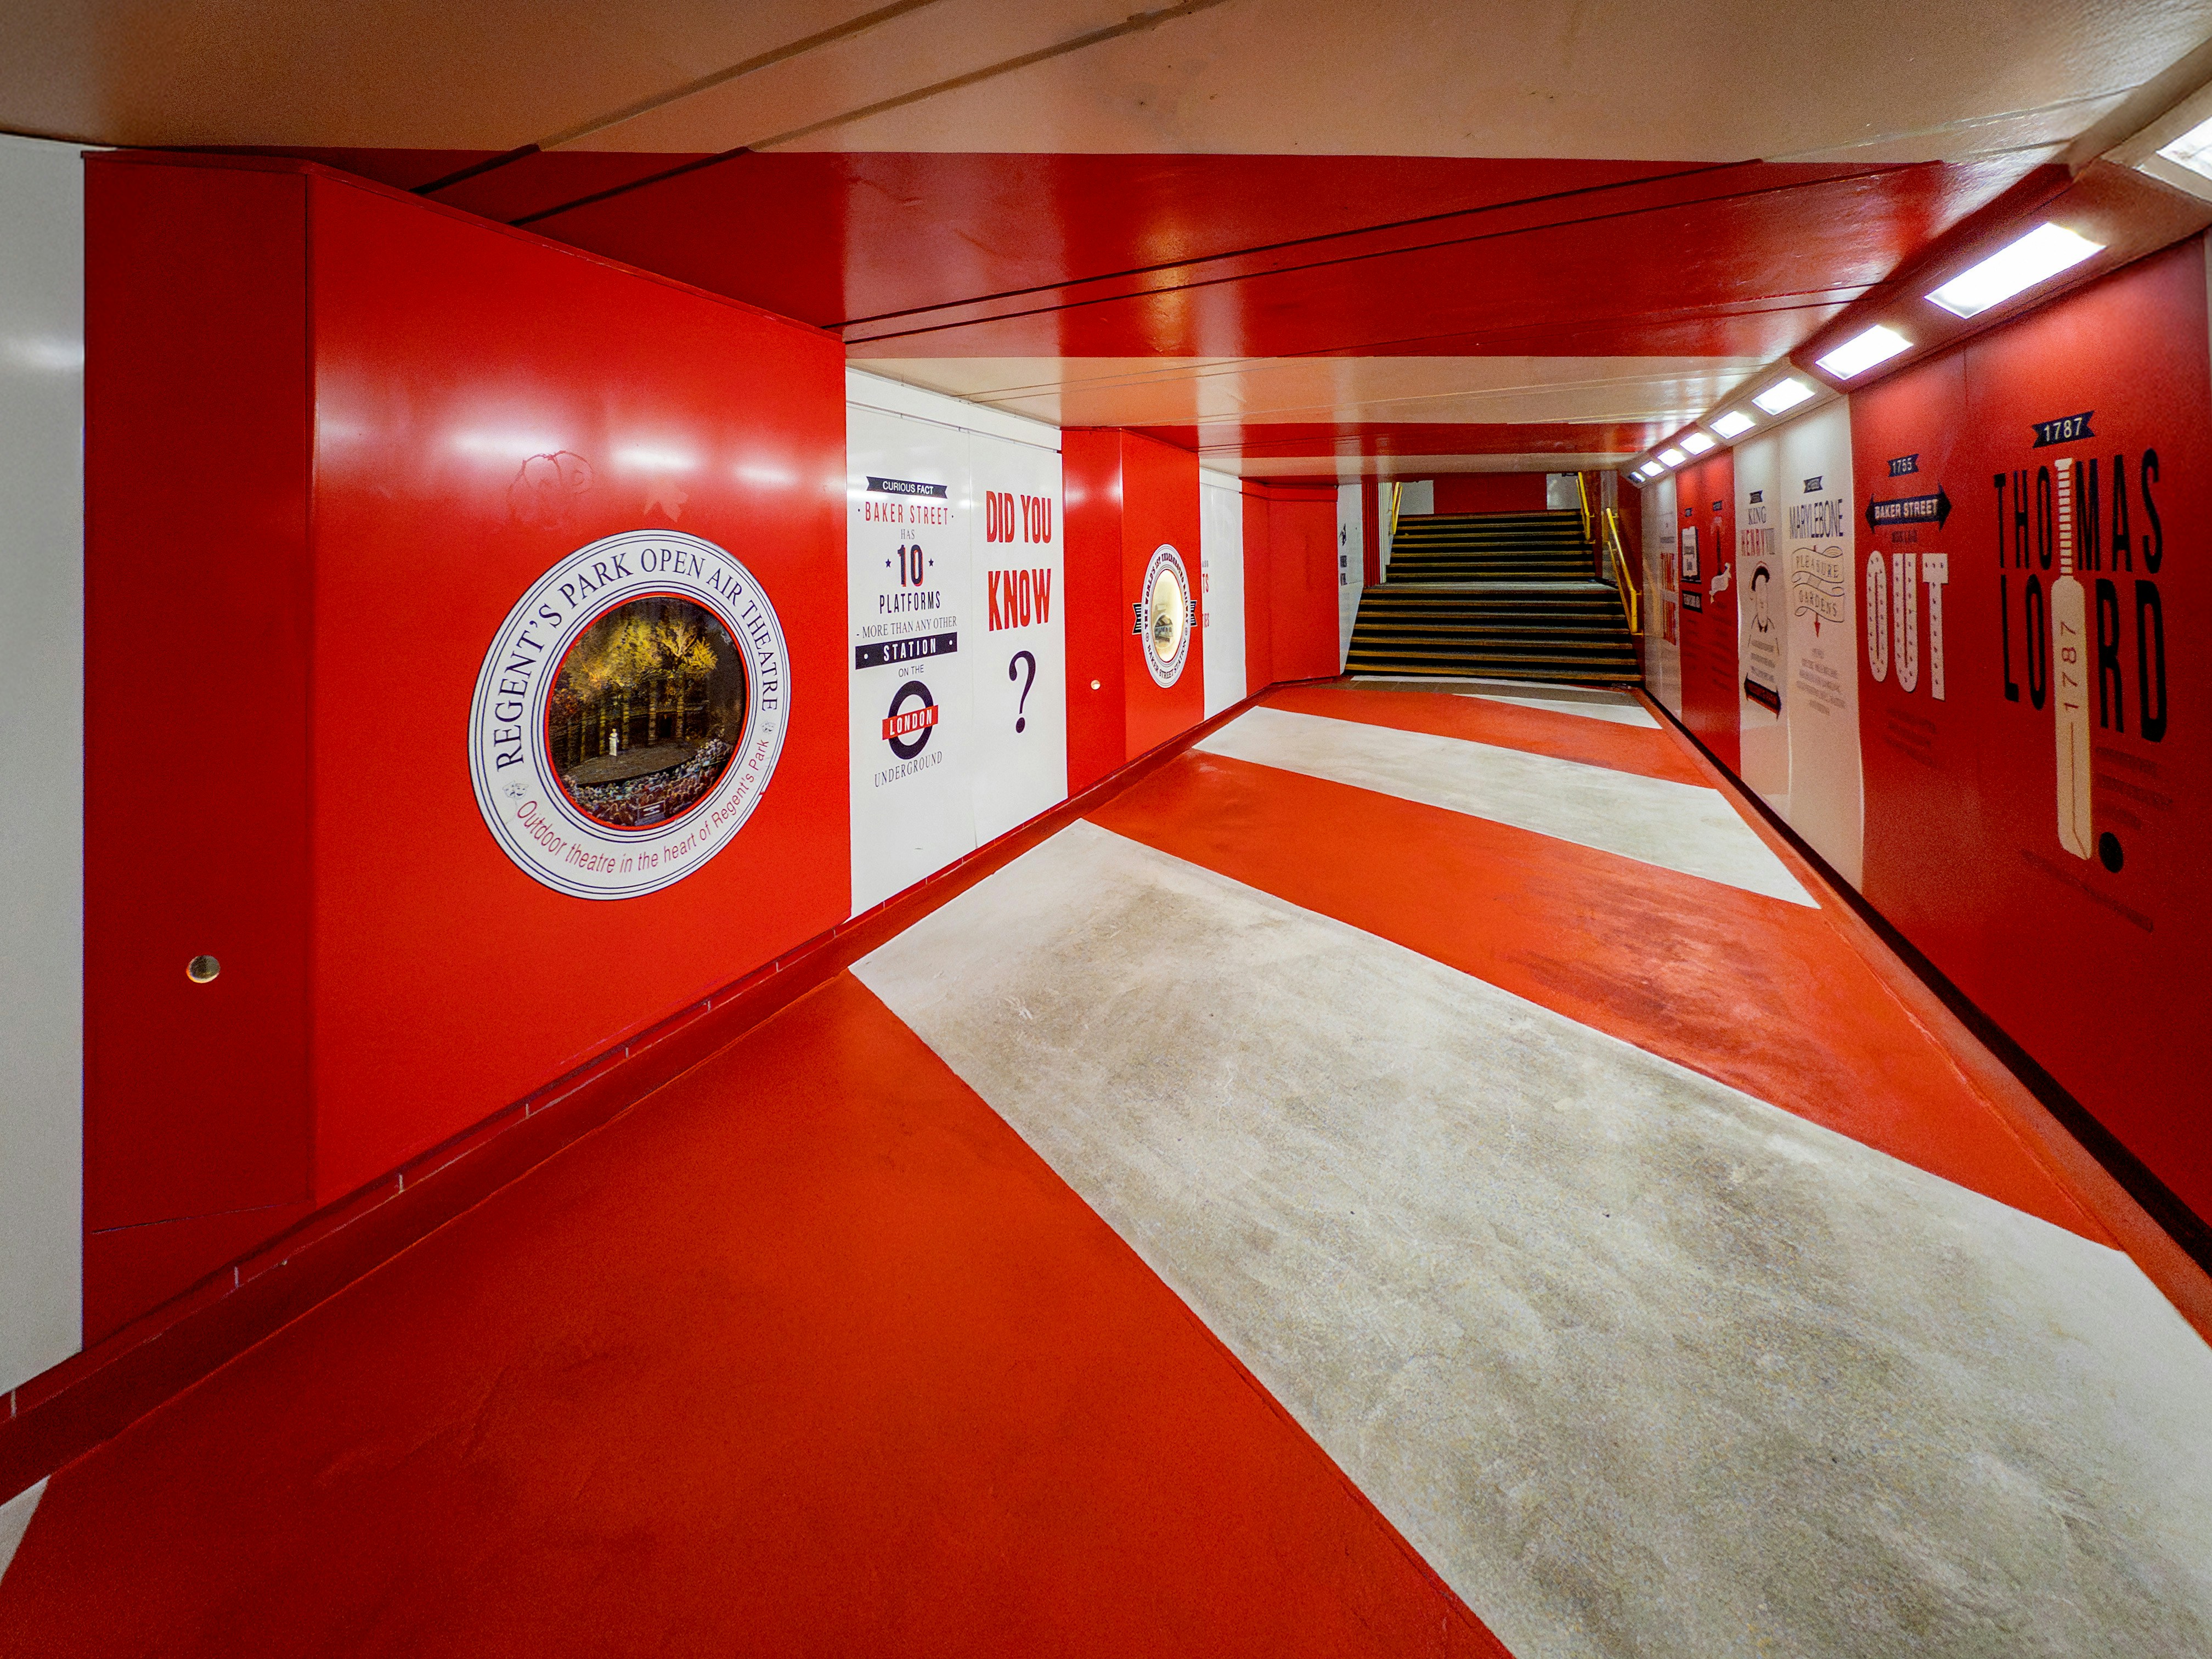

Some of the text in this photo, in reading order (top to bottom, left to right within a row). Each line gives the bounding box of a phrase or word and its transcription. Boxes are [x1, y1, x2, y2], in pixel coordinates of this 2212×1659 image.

[2044, 417, 2083, 442] 1787
[882, 481, 934, 494] CURIOUS FACT
[865, 501, 948, 525] BAKER STREET
[986, 490, 1051, 544] DID YOU
[1748, 506, 1767, 526] KING
[1789, 498, 1844, 539] MARYLEBONE
[1874, 499, 1939, 519] BAKER STREET
[1994, 448, 2163, 574] THOMAS
[900, 529, 915, 540] HAS
[897, 544, 923, 587] 10
[1796, 555, 1838, 578] PLEASURE
[879, 591, 940, 614] PLATFORMS
[988, 568, 1051, 631] KNOW
[1799, 590, 1837, 617] GARDENS
[557, 552, 634, 609] PARK
[641, 549, 706, 579] OPEN
[706, 567, 743, 607] AIR
[741, 600, 778, 712] THEATRE
[862, 624, 889, 639] MORE
[891, 621, 913, 635] THAN
[915, 619, 932, 631] ANY
[933, 616, 957, 629] OTHER
[1866, 550, 1949, 701] OUT
[883, 637, 936, 662] STATION
[2000, 574, 2168, 743] LORD
[898, 664, 924, 678] ON THE
[1159, 668, 1174, 679] STREET
[2060, 621, 2079, 711] 1787
[1009, 651, 1036, 733] ?
[889, 708, 933, 736] LONDON
[874, 751, 943, 787] UNDERGROUND
[517, 740, 769, 873] Outdoor theatre in the heart of Regent's Park
